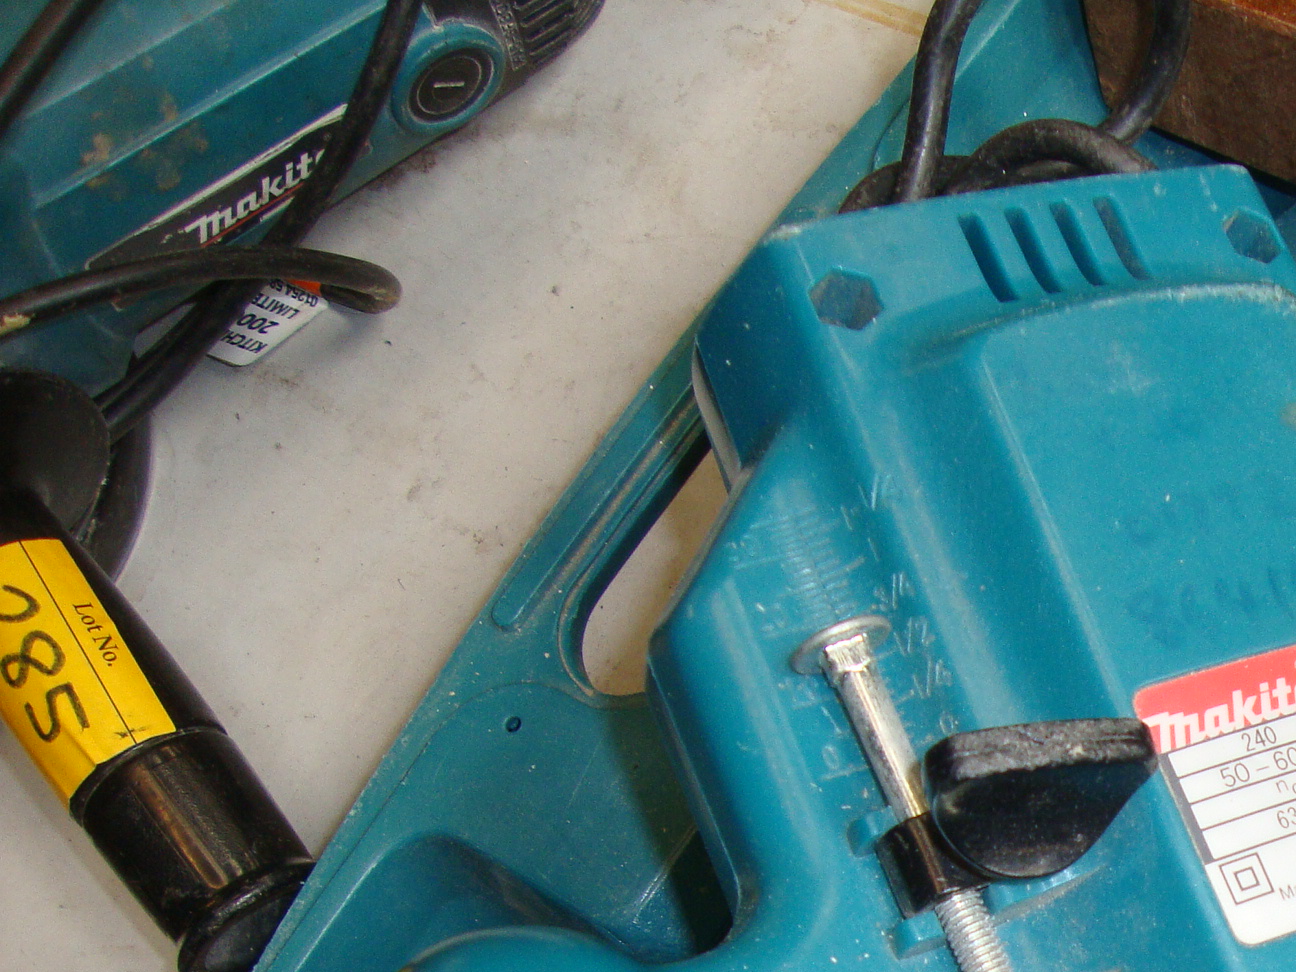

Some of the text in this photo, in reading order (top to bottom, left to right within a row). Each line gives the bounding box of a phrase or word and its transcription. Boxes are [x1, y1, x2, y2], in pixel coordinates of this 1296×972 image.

[73, 602, 119, 667] Lot No.
[1241, 725, 1277, 752] 240
[1219, 762, 1251, 788] 50
